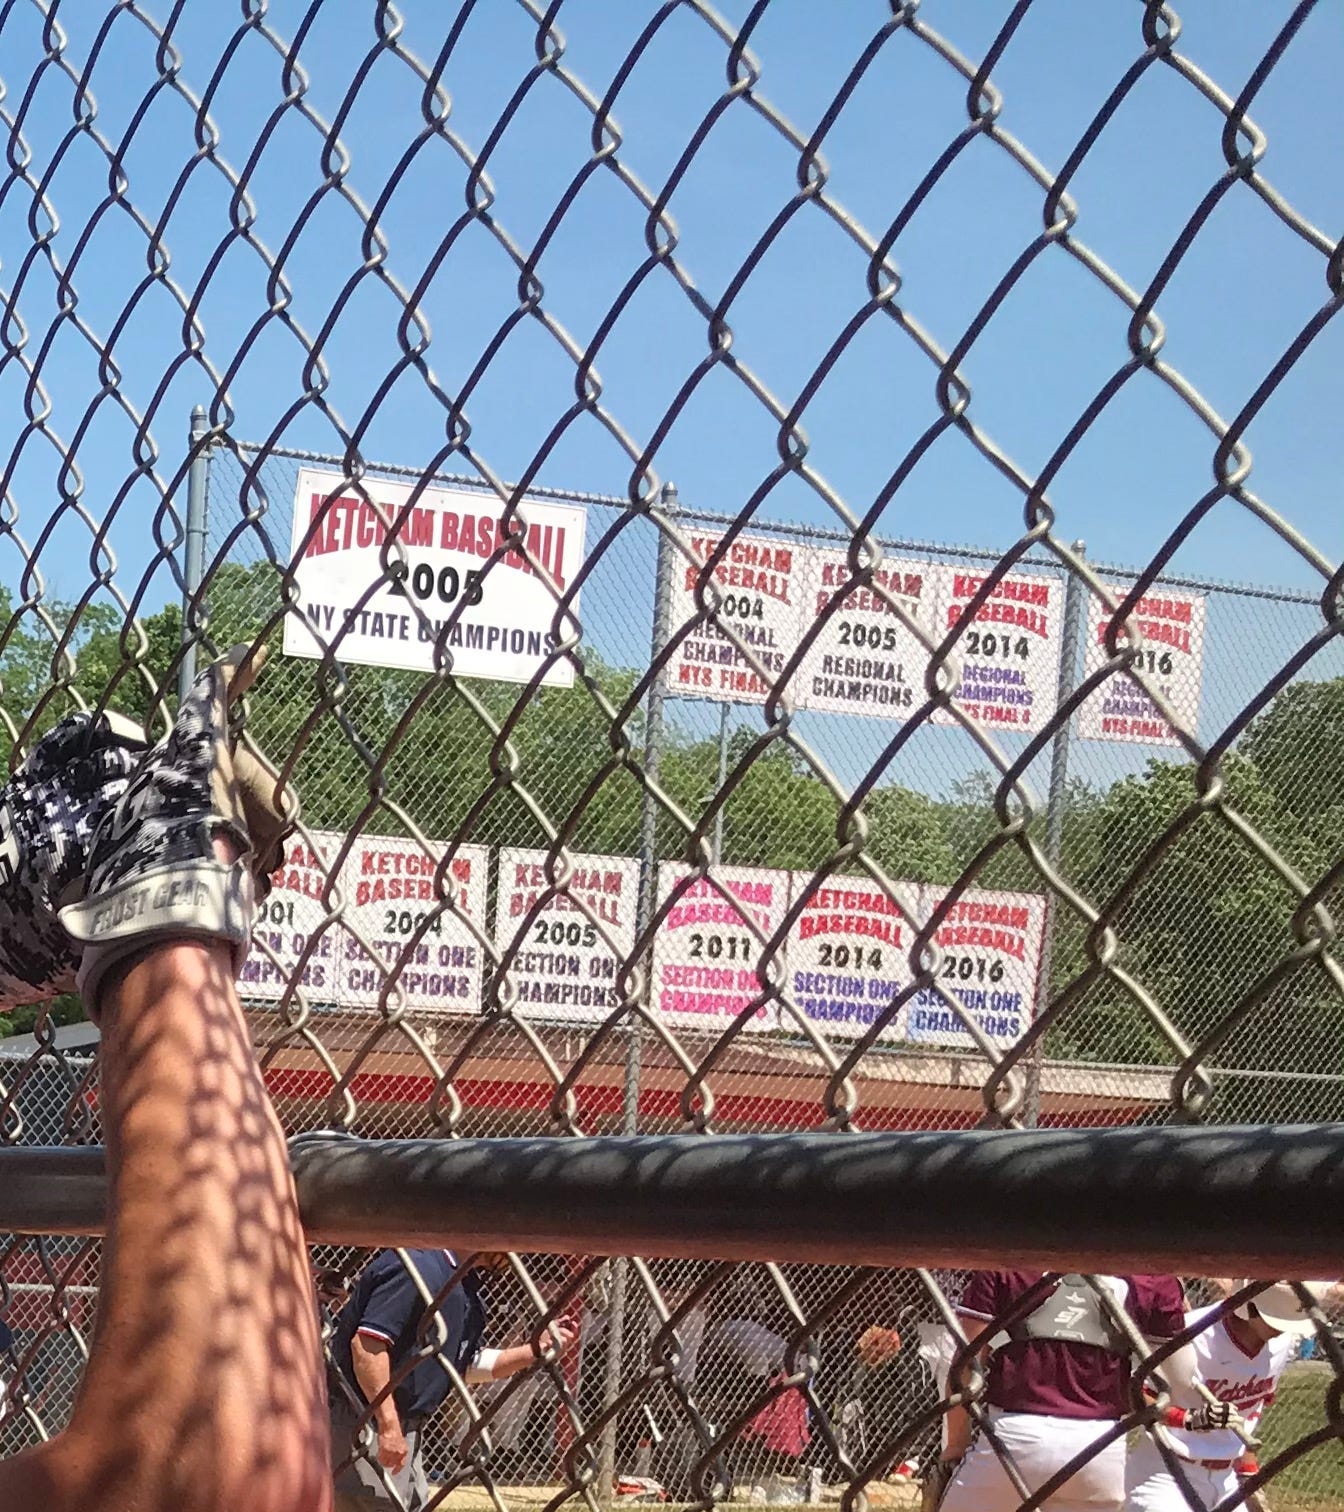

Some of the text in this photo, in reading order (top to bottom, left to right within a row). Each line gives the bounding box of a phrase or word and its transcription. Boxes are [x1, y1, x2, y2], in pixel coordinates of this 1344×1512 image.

[692, 537, 792, 574] KECHAM
[387, 560, 483, 606] 2005
[685, 565, 791, 606] BSEBALL
[822, 562, 923, 599] KEHAM
[953, 574, 1049, 607] KECHAM
[712, 594, 764, 620] 004
[947, 603, 1049, 639] BSEBALL
[307, 603, 336, 631] NY
[343, 608, 410, 641] STATE
[693, 622, 778, 648] RENAL
[838, 621, 896, 650] 2005
[966, 631, 1029, 660] 2014
[1097, 621, 1191, 655] BEBALL
[684, 640, 785, 672] CHAMPNS
[822, 654, 906, 683] REGIONAL
[679, 663, 713, 687] NYS
[812, 676, 914, 707] CHAMPIONS
[361, 851, 471, 884] KETCHM
[515, 863, 623, 897] KEHAM
[356, 878, 472, 916] BASEBL
[258, 901, 294, 925] 001
[667, 903, 771, 932] BASEBL
[934, 900, 1029, 930] ETCHAM
[534, 920, 597, 948] 2005
[799, 914, 903, 950] BASEBALL
[345, 938, 476, 968] STIN ONE
[689, 933, 750, 961] 2011
[818, 943, 883, 971] 2014
[512, 951, 580, 976] ECTION
[942, 956, 1004, 983] 2016
[348, 968, 470, 998] CHPIONS
[517, 981, 618, 1008] HAMPIONS
[794, 971, 864, 999] SECTION
[991, 992, 1022, 1013] ONE
[916, 1010, 1020, 1038] CHAONS
